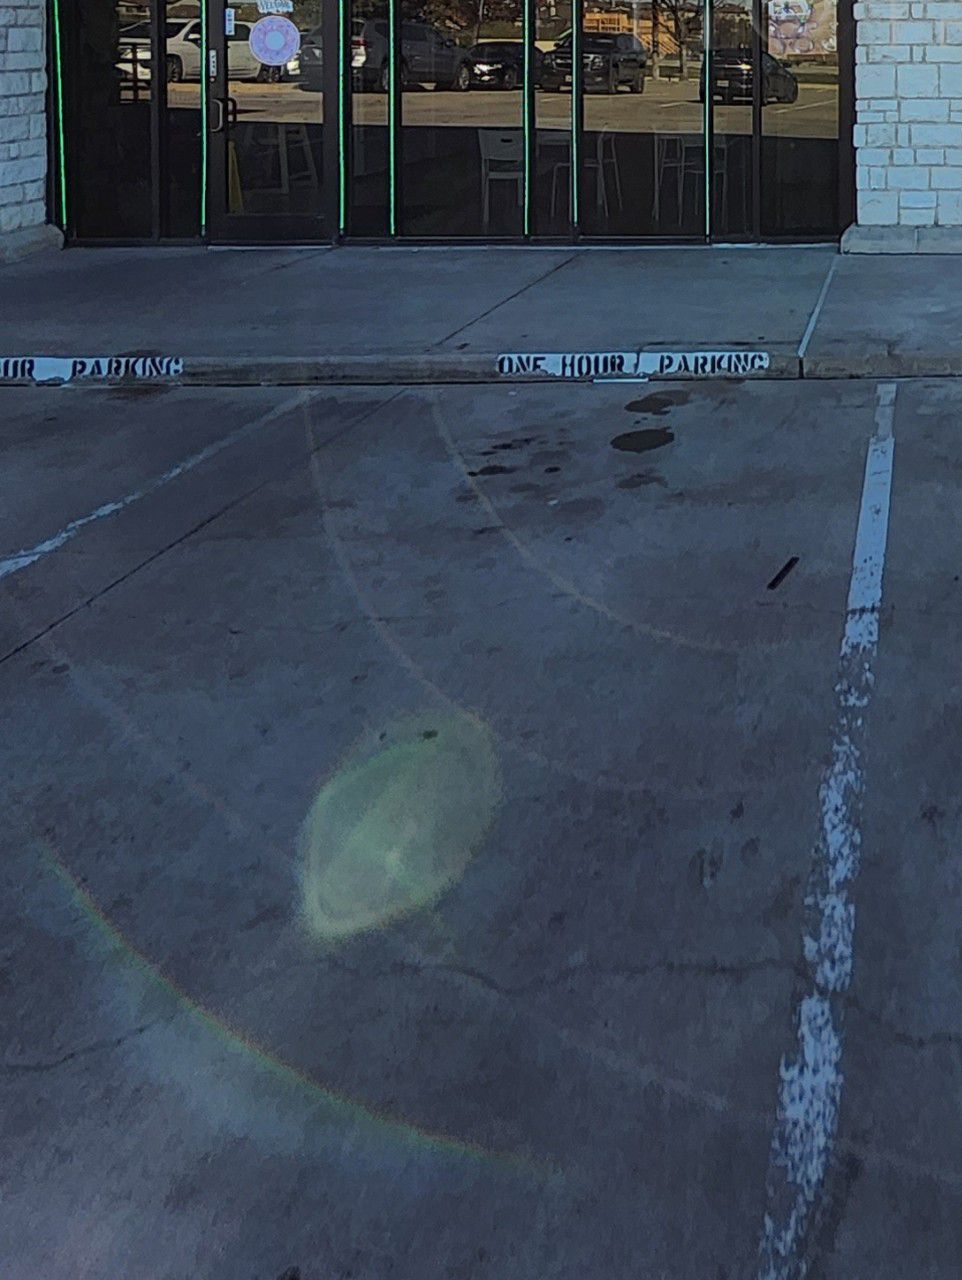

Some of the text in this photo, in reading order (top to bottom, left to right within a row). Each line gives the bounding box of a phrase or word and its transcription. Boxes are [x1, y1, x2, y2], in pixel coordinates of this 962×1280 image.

[71, 358, 183, 377] PARKING
[500, 353, 770, 376] ONE HOUR PARKING
